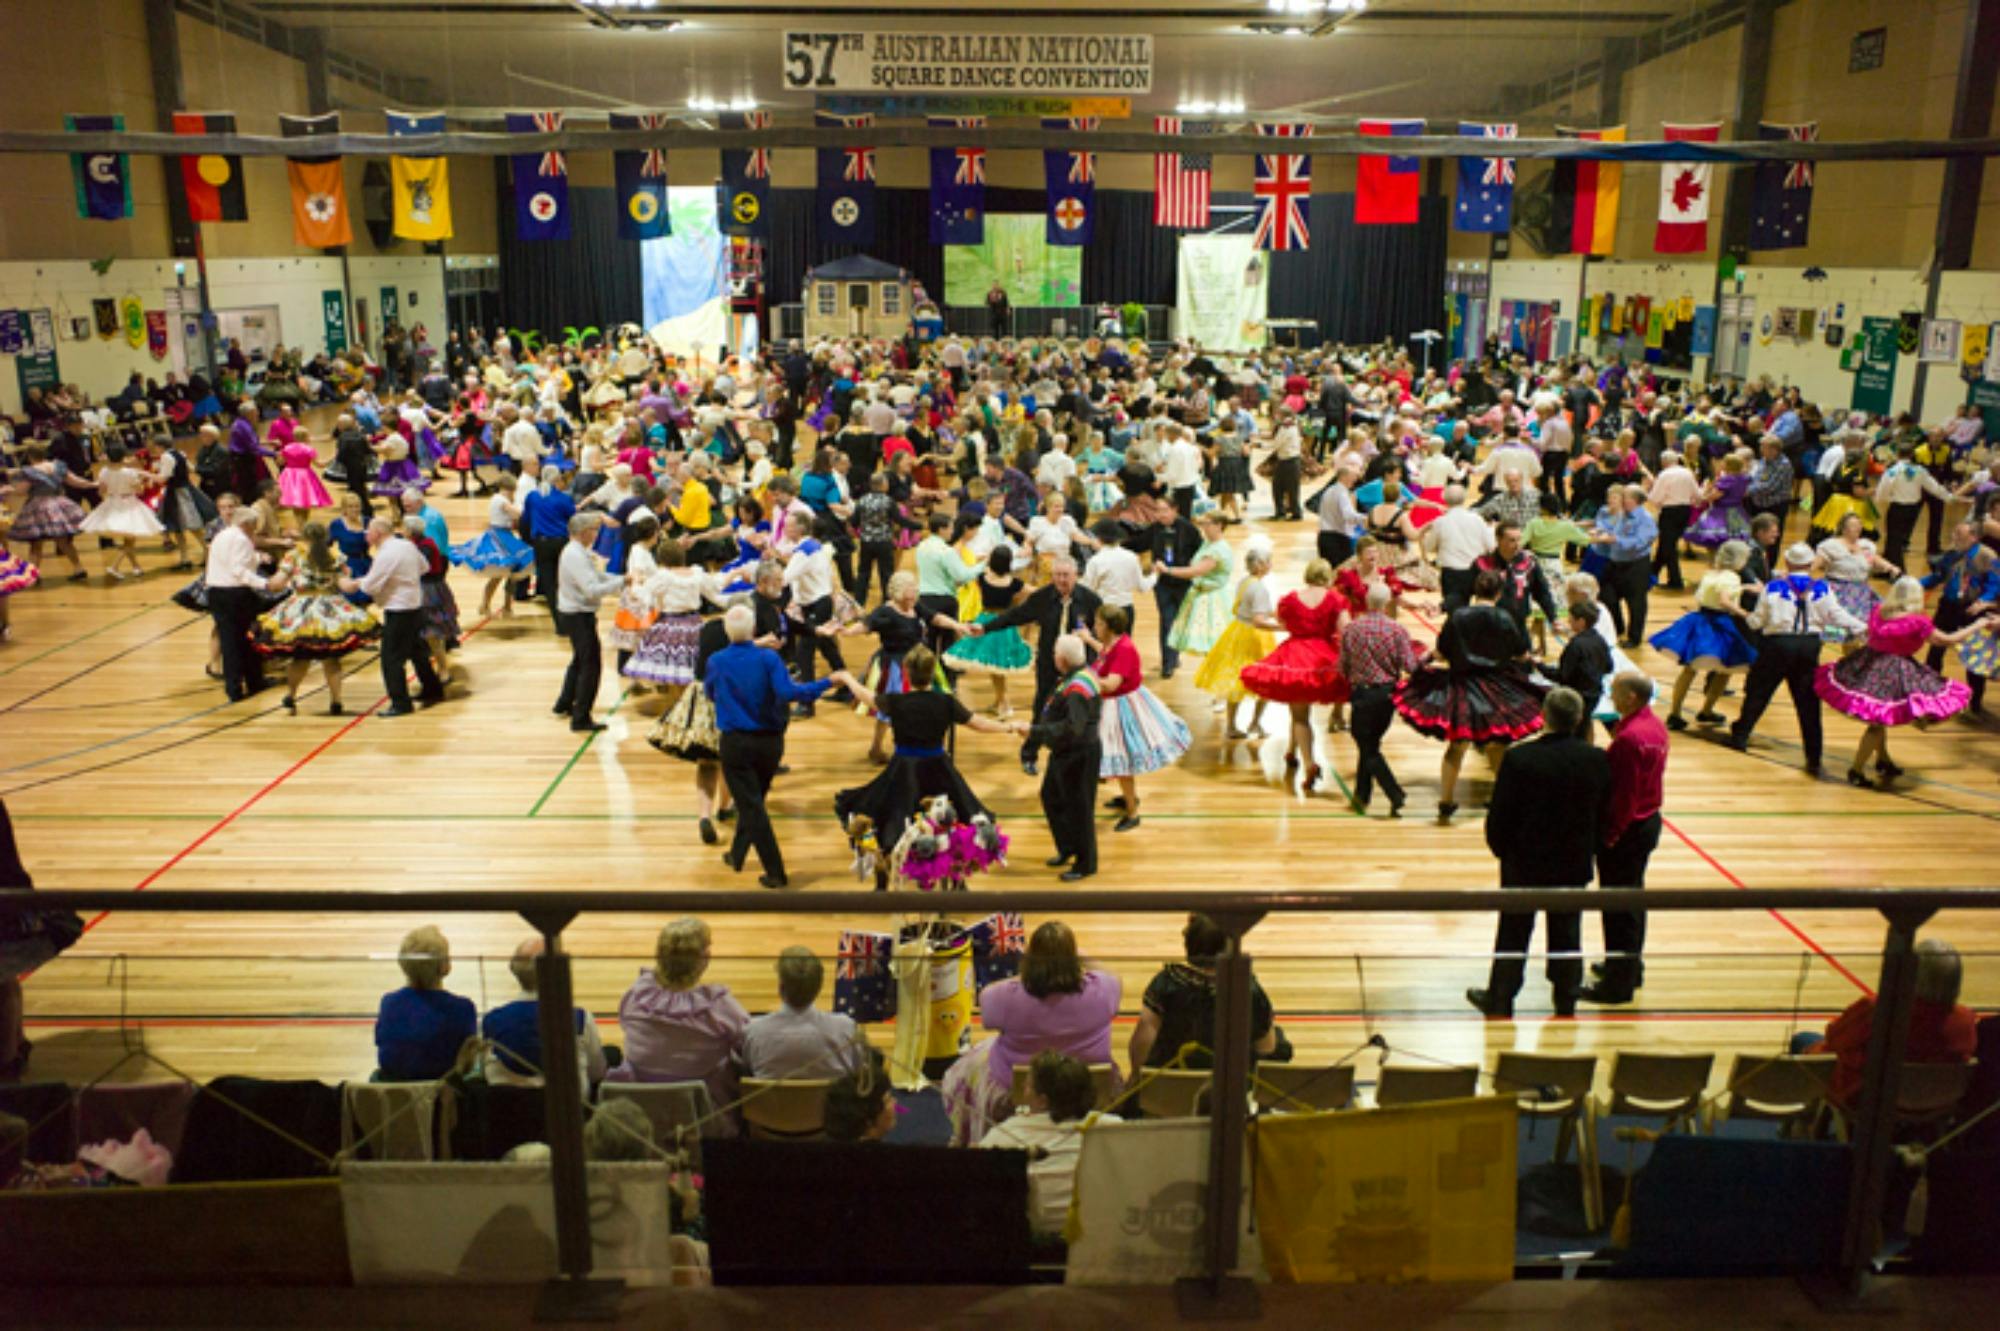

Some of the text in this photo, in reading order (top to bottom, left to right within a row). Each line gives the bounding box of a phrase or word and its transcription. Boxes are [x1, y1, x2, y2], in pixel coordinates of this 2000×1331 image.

[871, 34, 1021, 63] AUSTRALIAN
[1027, 35, 1149, 65] NATIONAL
[871, 64, 1149, 88] SQUARE DANCE CONVENTION
